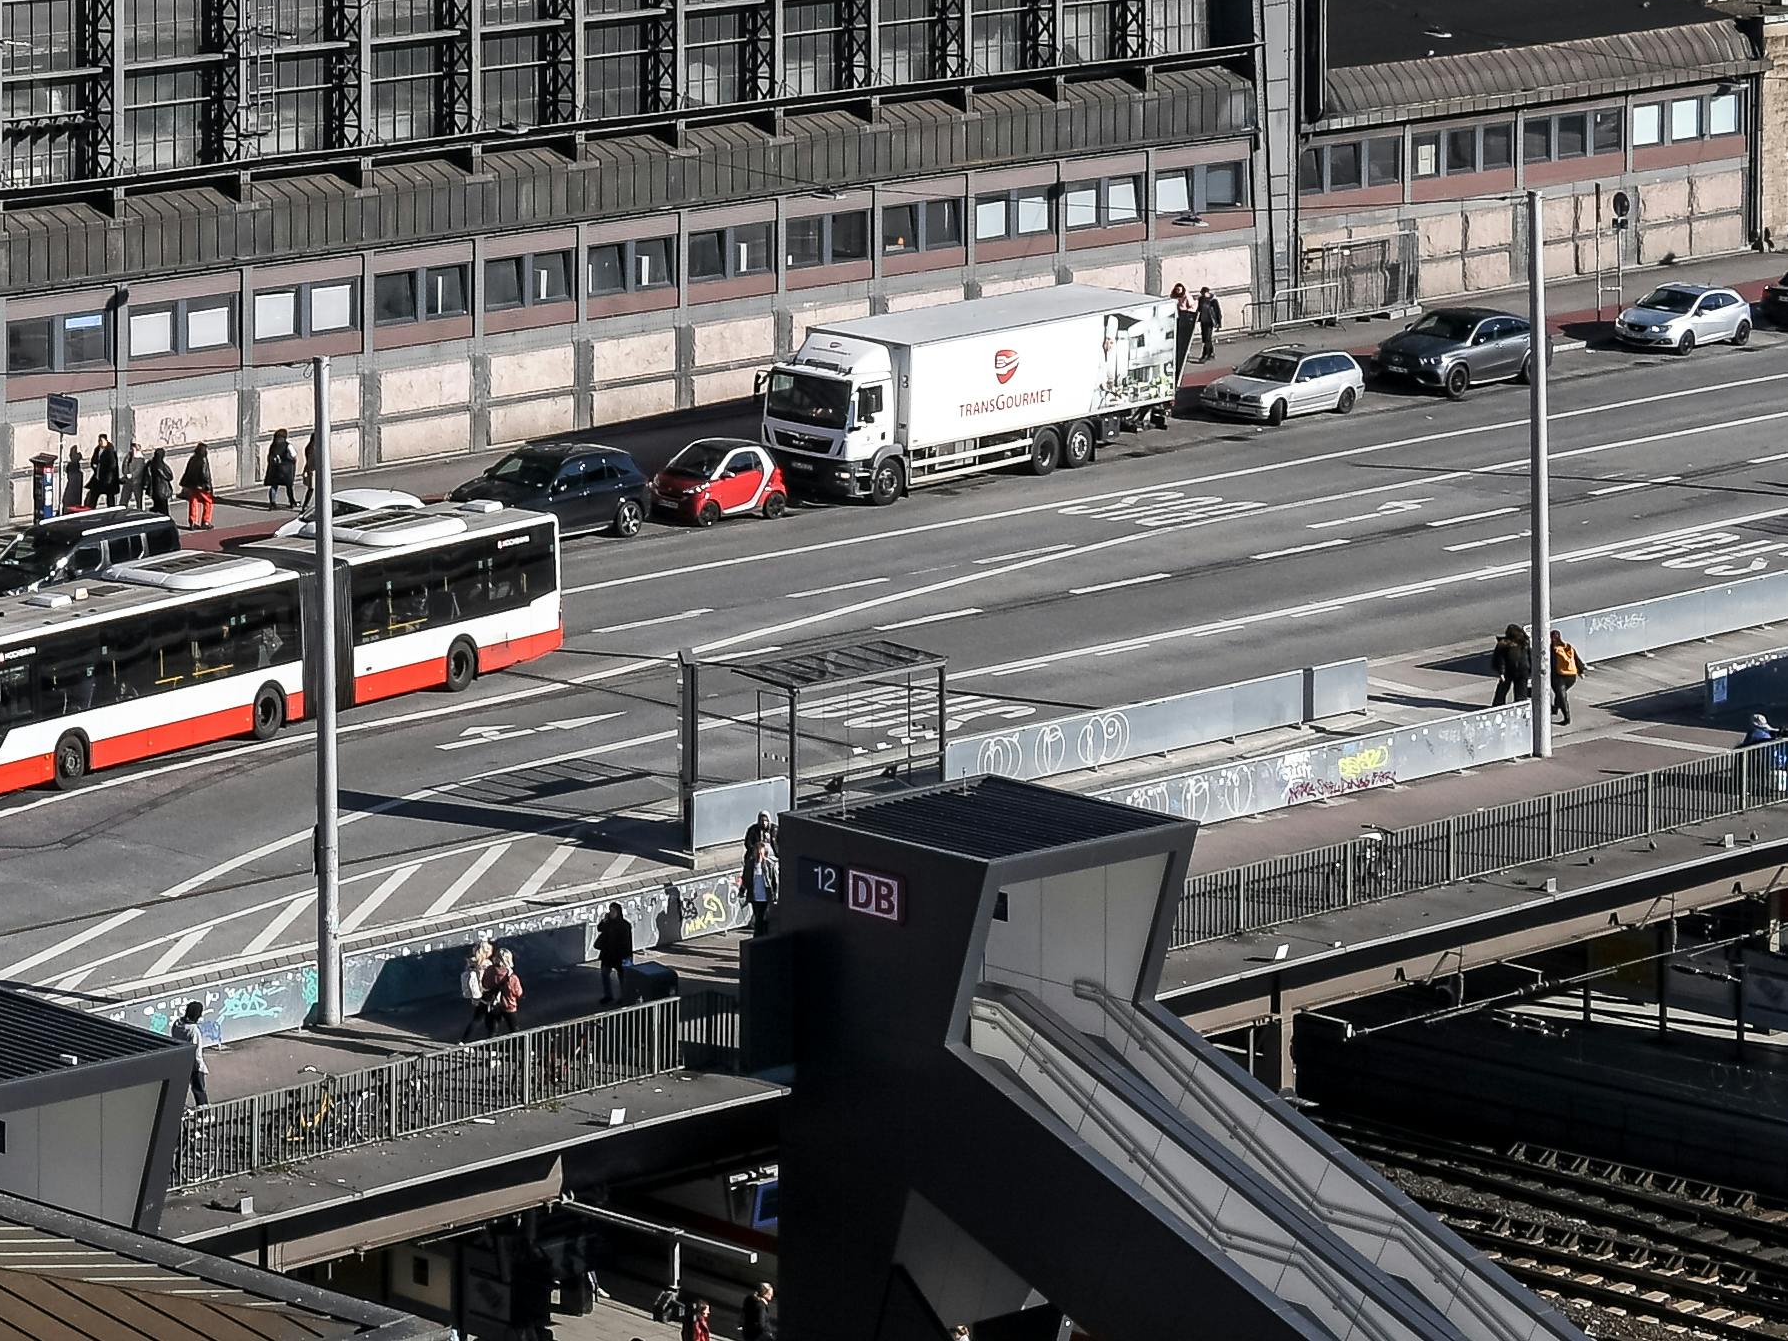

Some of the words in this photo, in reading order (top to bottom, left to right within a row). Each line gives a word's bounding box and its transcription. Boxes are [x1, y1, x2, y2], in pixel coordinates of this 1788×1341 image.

[959, 388, 1052, 417] TRANSGOURMET
[813, 866, 837, 893] 12
[850, 870, 898, 919] DB
